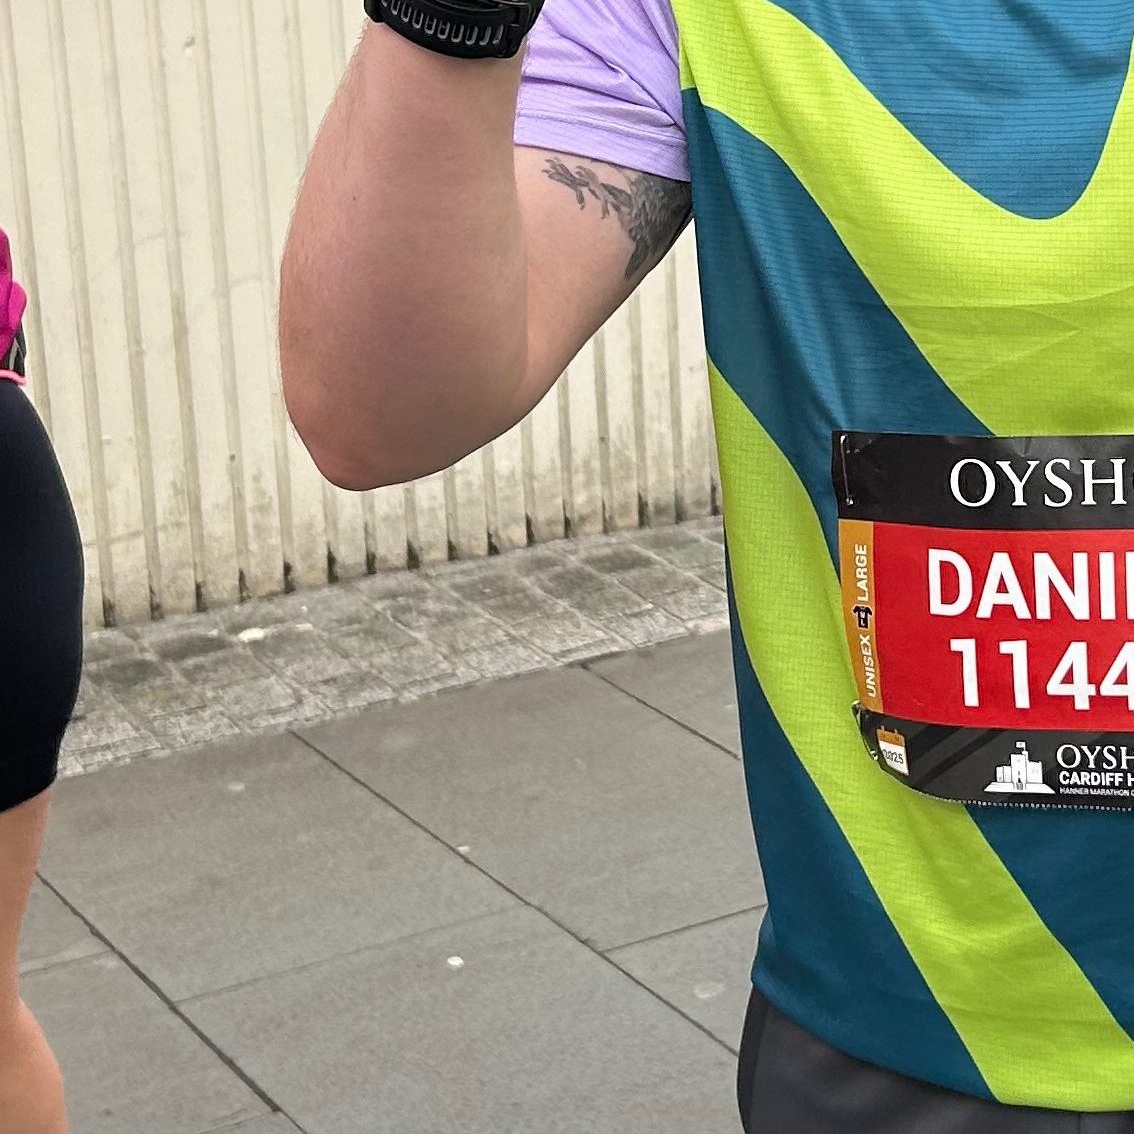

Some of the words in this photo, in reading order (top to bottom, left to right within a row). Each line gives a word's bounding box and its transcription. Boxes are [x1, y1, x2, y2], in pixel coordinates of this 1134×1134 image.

[854, 543, 869, 602] LARGE
[859, 633, 877, 698] UNISEX
[1059, 770, 1124, 787] CARDIFF
[1090, 788, 1130, 796] MARATHON
